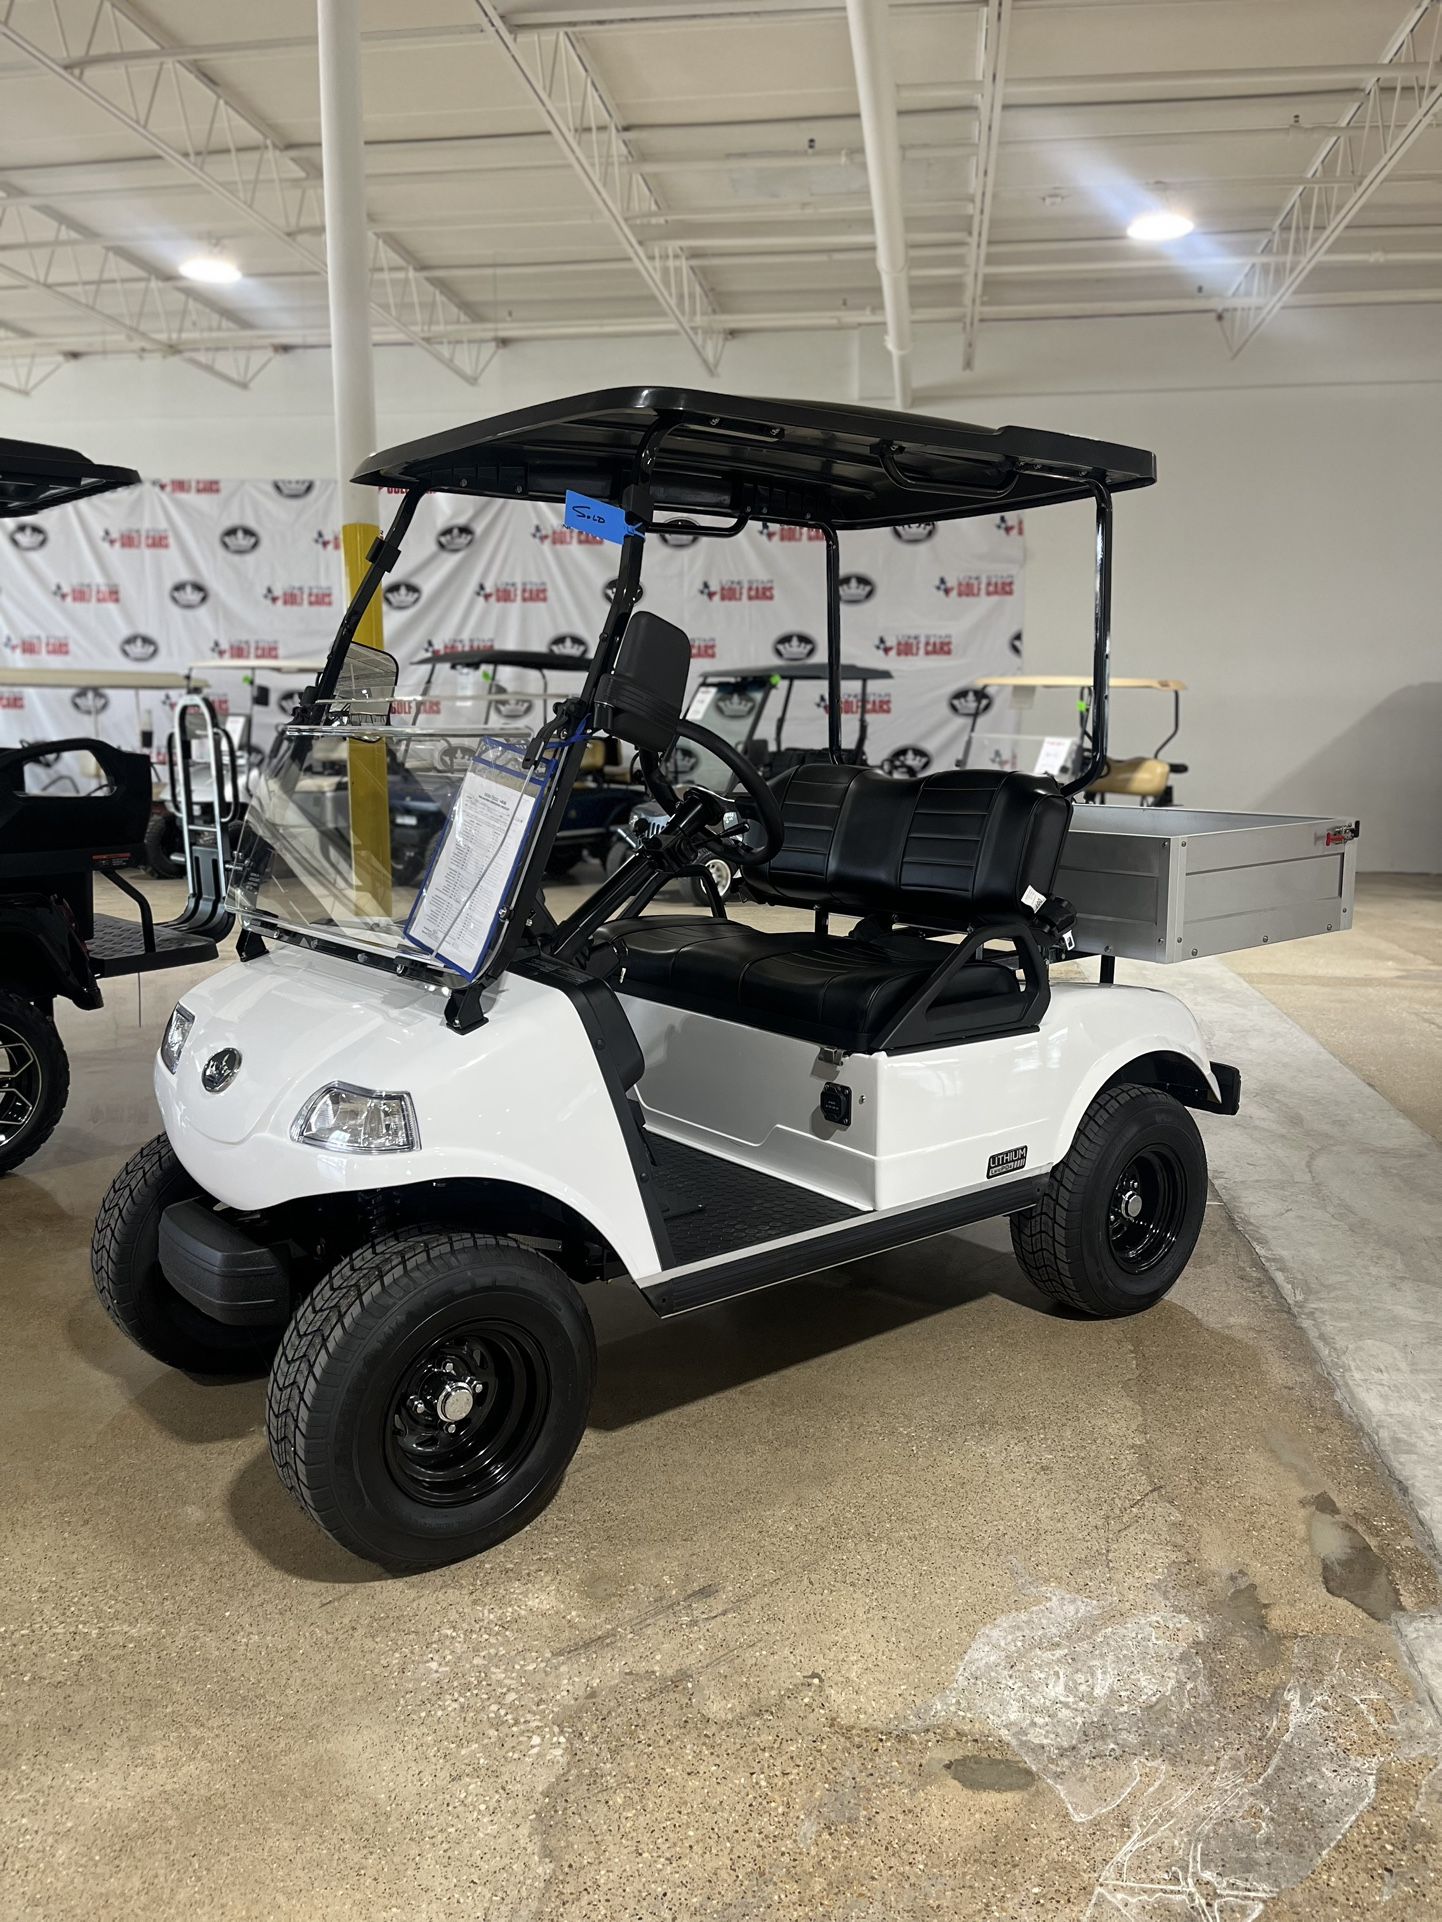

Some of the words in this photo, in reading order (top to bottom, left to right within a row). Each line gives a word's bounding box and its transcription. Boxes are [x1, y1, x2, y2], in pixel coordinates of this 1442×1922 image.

[747, 585, 774, 601] CARS
[985, 580, 1013, 596] CARS
[925, 640, 952, 656] CARS
[990, 1147, 1026, 1167] LITHIUM
